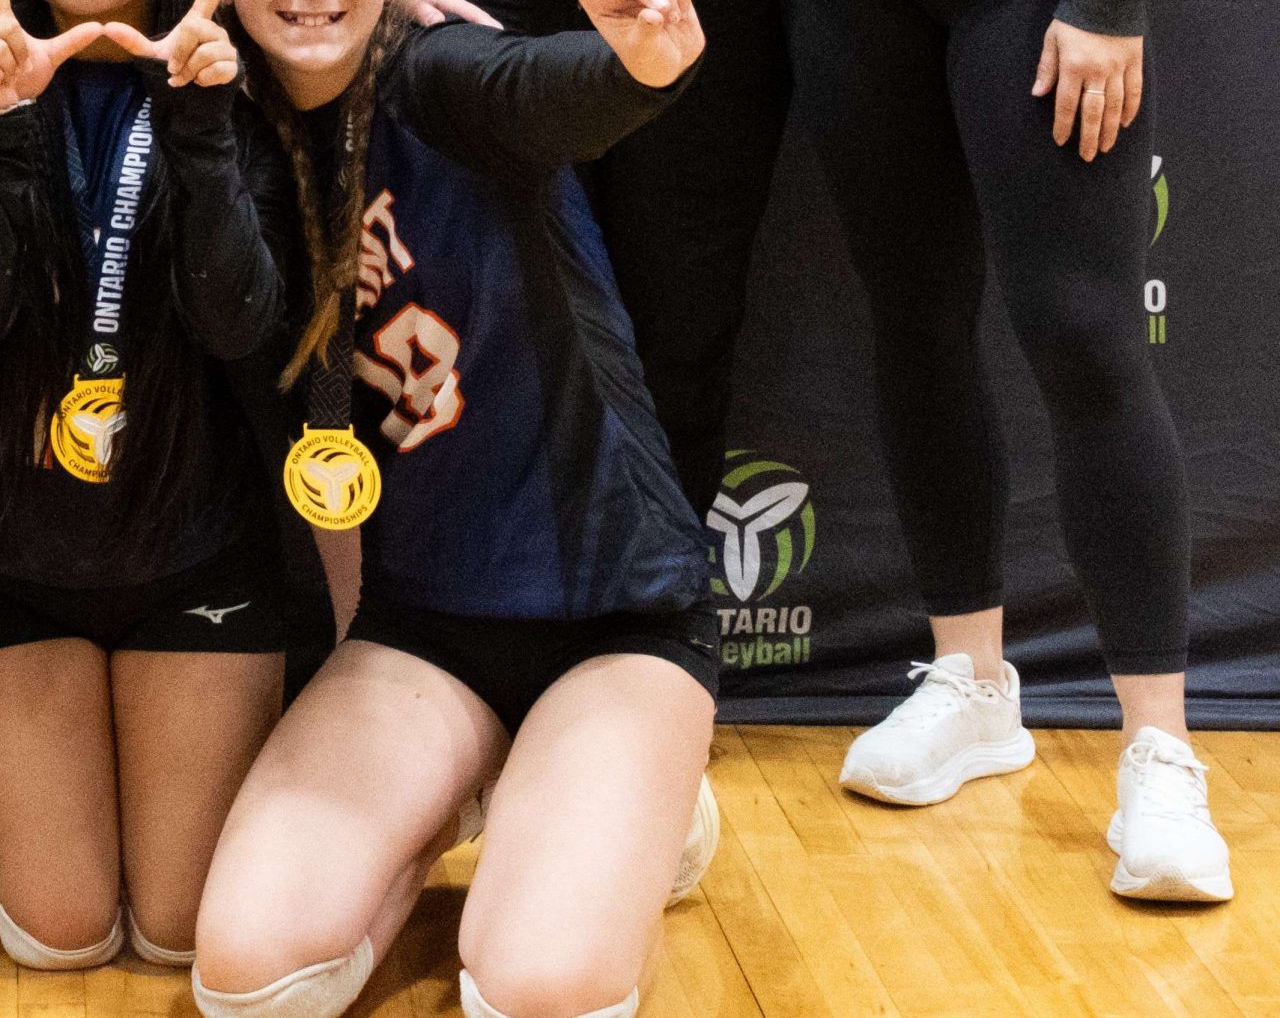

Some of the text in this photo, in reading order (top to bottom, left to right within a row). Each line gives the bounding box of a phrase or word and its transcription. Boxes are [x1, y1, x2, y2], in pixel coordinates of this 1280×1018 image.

[93, 238, 131, 334] ONTARIO
[291, 435, 370, 467] ONTARIO VOLLEYBALL
[301, 504, 368, 525] CHAMPIONSHIPS
